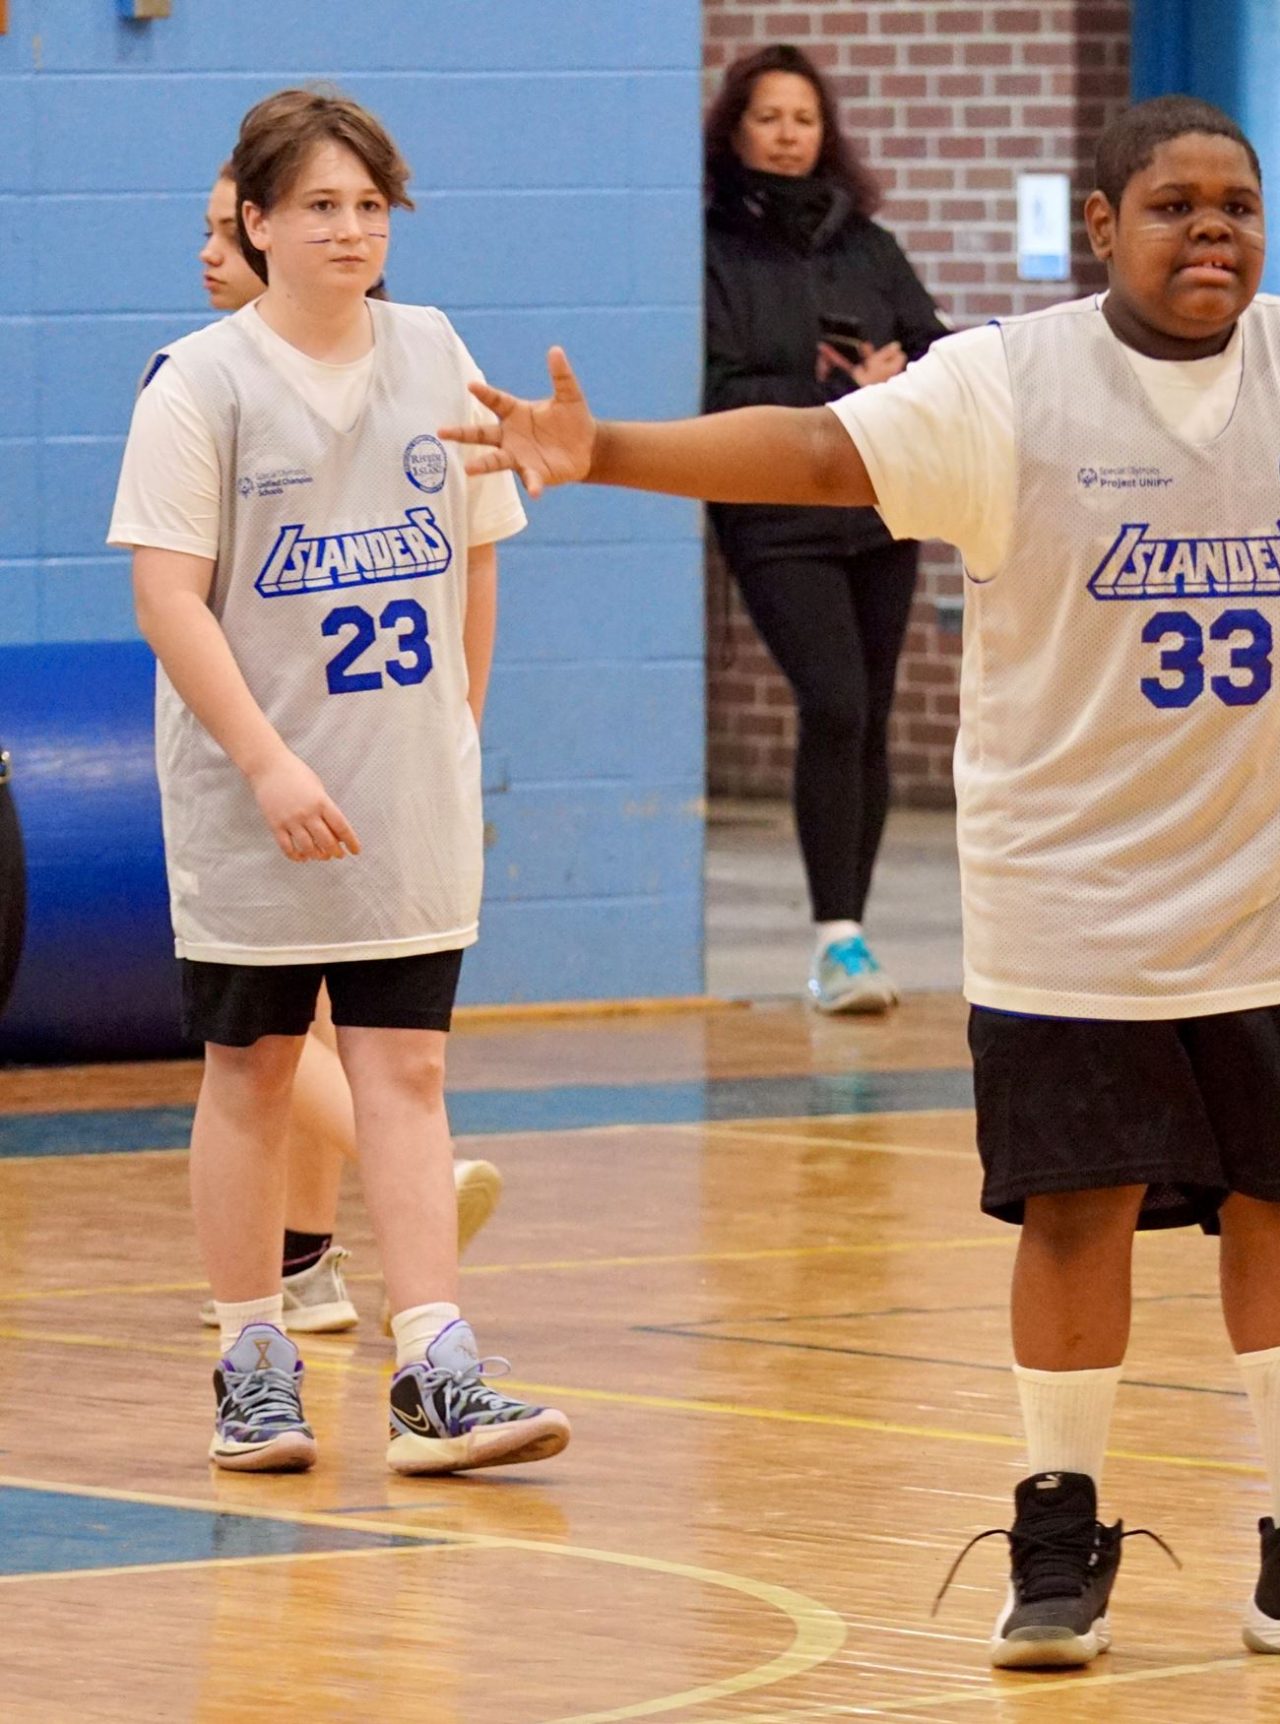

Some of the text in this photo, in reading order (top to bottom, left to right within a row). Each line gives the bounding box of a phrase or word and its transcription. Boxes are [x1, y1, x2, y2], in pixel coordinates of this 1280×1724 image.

[1100, 479, 1136, 488] Project
[254, 506, 452, 598] ISLANDERS
[321, 599, 433, 694] 23
[1141, 609, 1273, 708] 33
